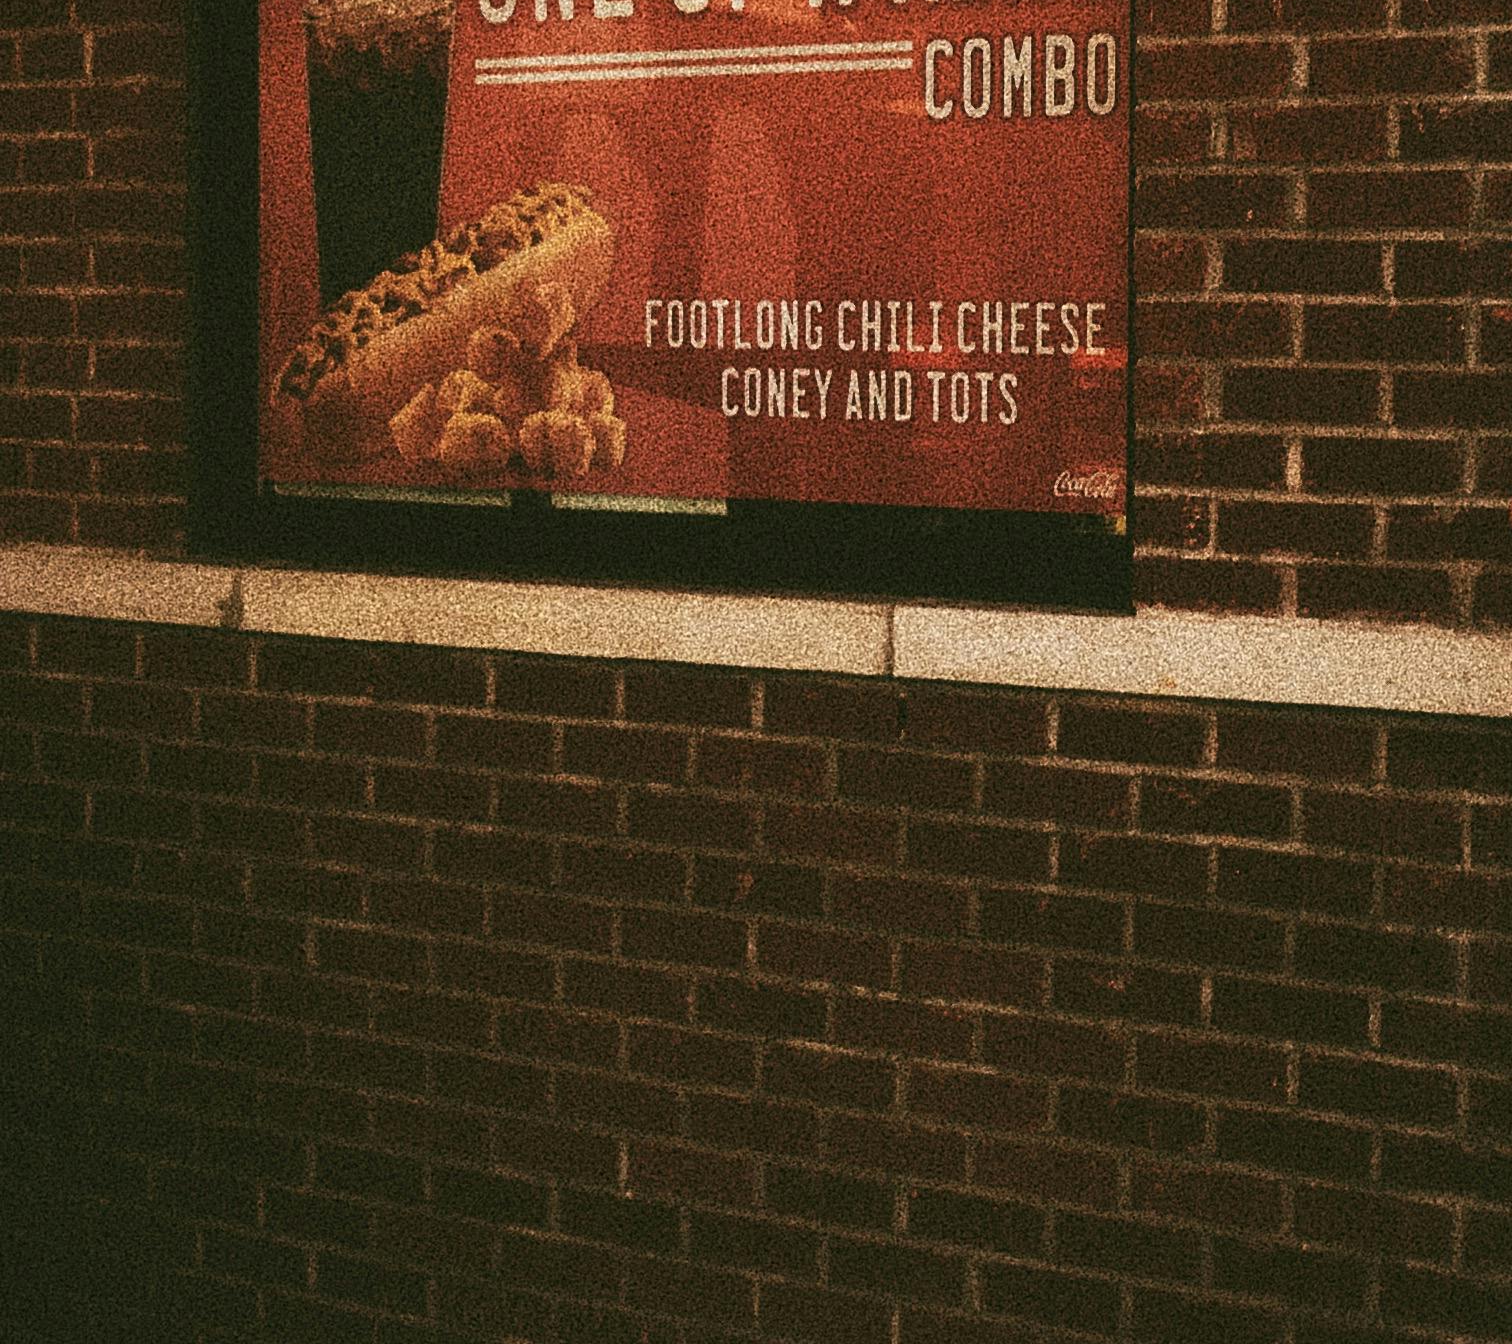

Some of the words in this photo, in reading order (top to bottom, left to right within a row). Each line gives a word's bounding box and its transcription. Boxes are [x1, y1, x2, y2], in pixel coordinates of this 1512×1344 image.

[924, 32, 1117, 121] COMBO
[645, 297, 824, 352] FOOTLONG
[837, 299, 944, 354] CHILI
[957, 301, 1107, 356] CHEESE
[721, 366, 833, 421] CONEY
[845, 369, 914, 423] AND
[928, 371, 1019, 425] TOTS
